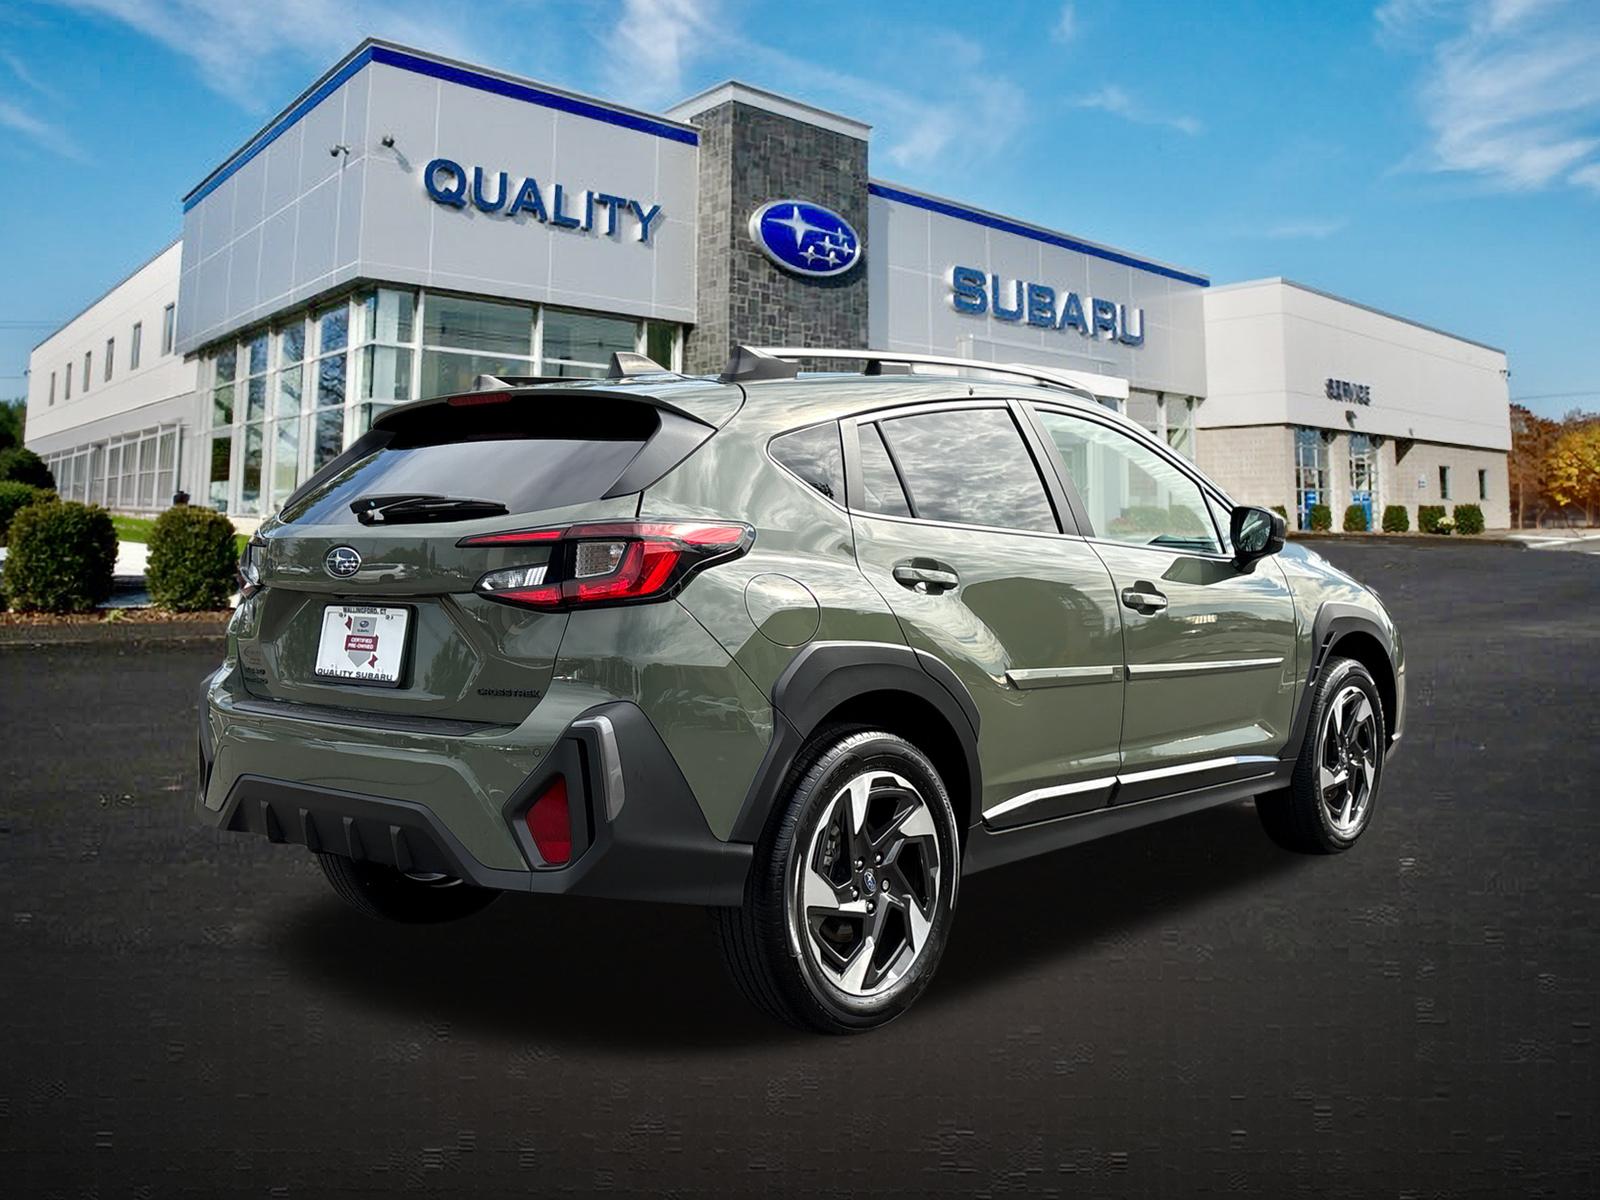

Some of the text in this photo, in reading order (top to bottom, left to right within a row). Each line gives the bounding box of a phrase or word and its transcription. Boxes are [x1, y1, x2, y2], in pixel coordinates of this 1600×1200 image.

[424, 158, 662, 243] QUALITY
[949, 265, 1145, 346] SUBARU
[1325, 377, 1372, 406] SERVICE
[317, 668, 393, 681] QUALITY SUBARU
[477, 687, 541, 698] CROSSTREK
